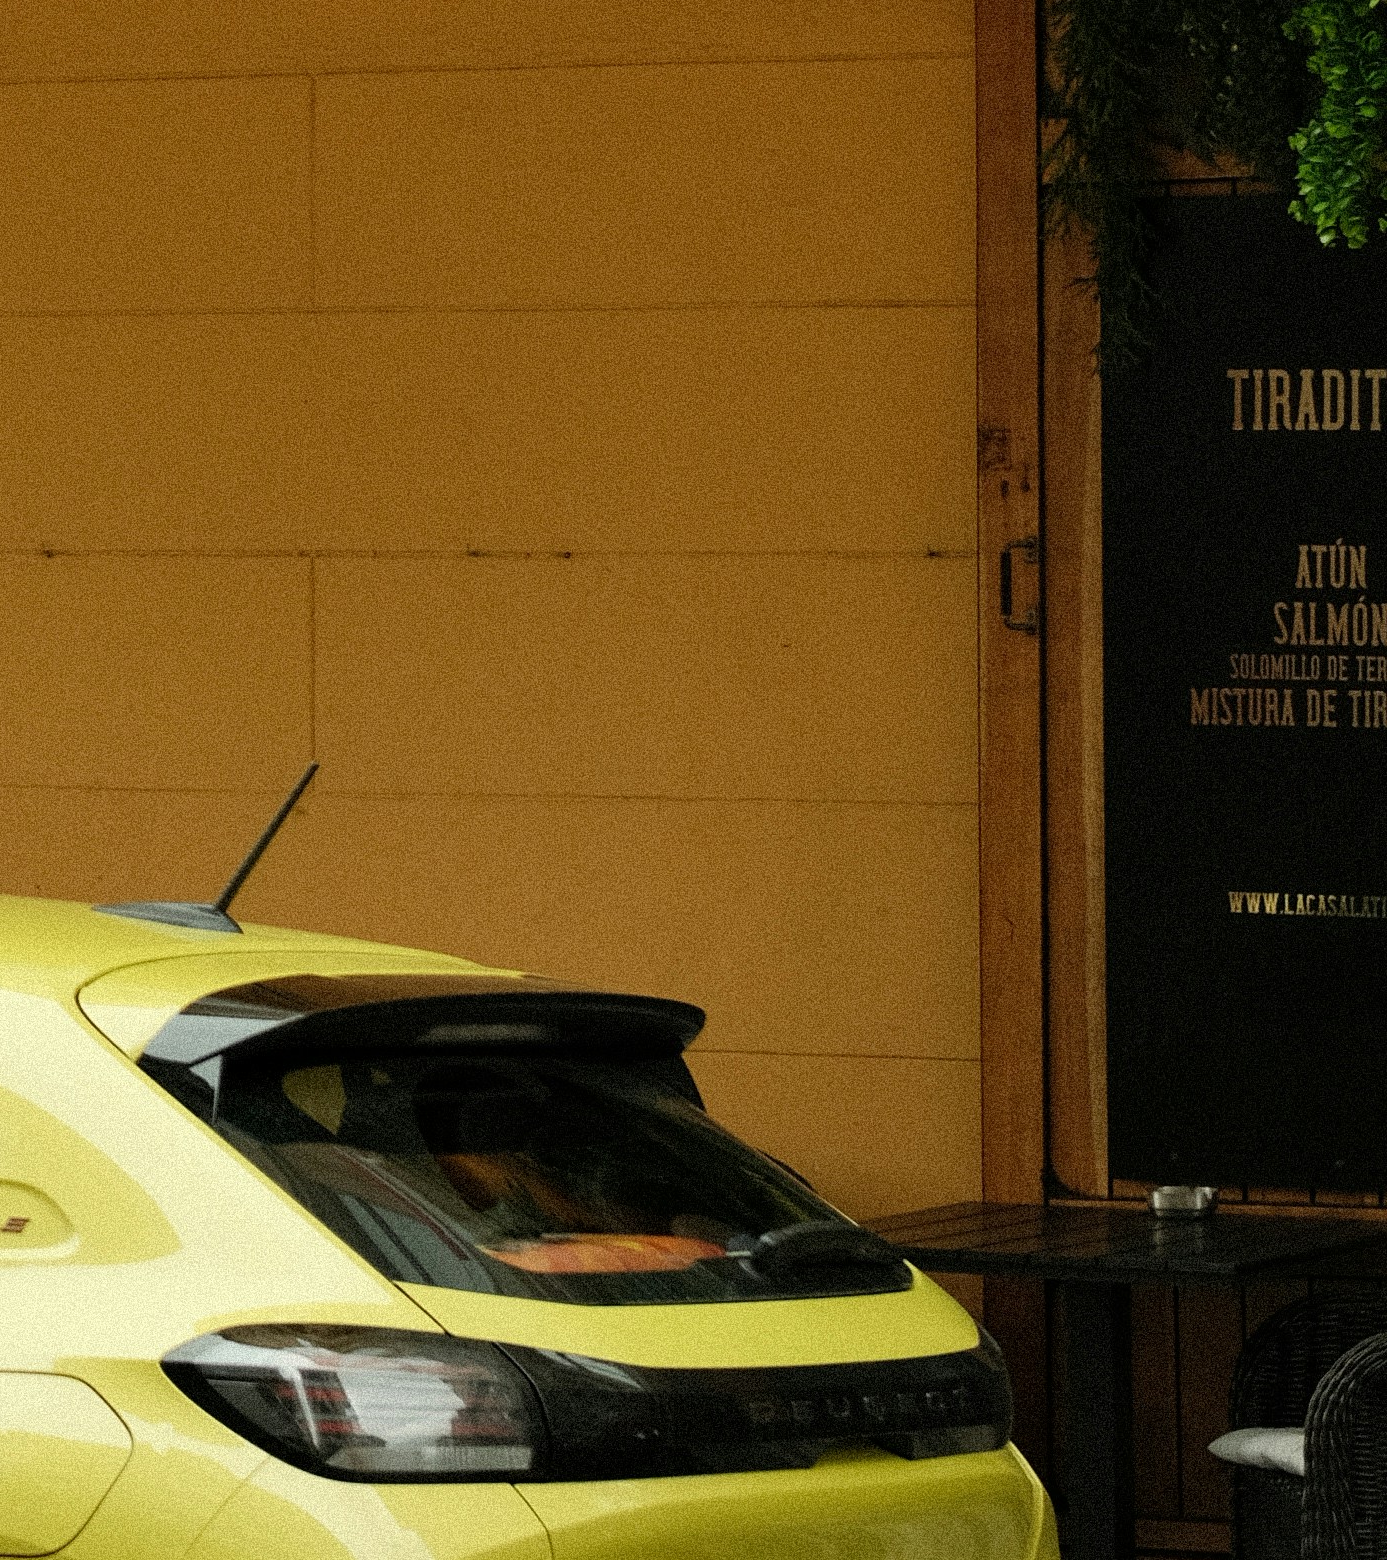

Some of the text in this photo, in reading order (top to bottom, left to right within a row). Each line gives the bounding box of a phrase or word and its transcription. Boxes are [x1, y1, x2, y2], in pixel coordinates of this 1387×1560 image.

[1227, 368, 1387, 431] TIRADIT
[1294, 537, 1367, 590] ATÚN
[1273, 594, 1387, 648] SALMÓN
[1229, 652, 1321, 681] SOLOMILLO
[1327, 654, 1350, 682] DE
[1189, 686, 1387, 729] MISTURA DE TIR
